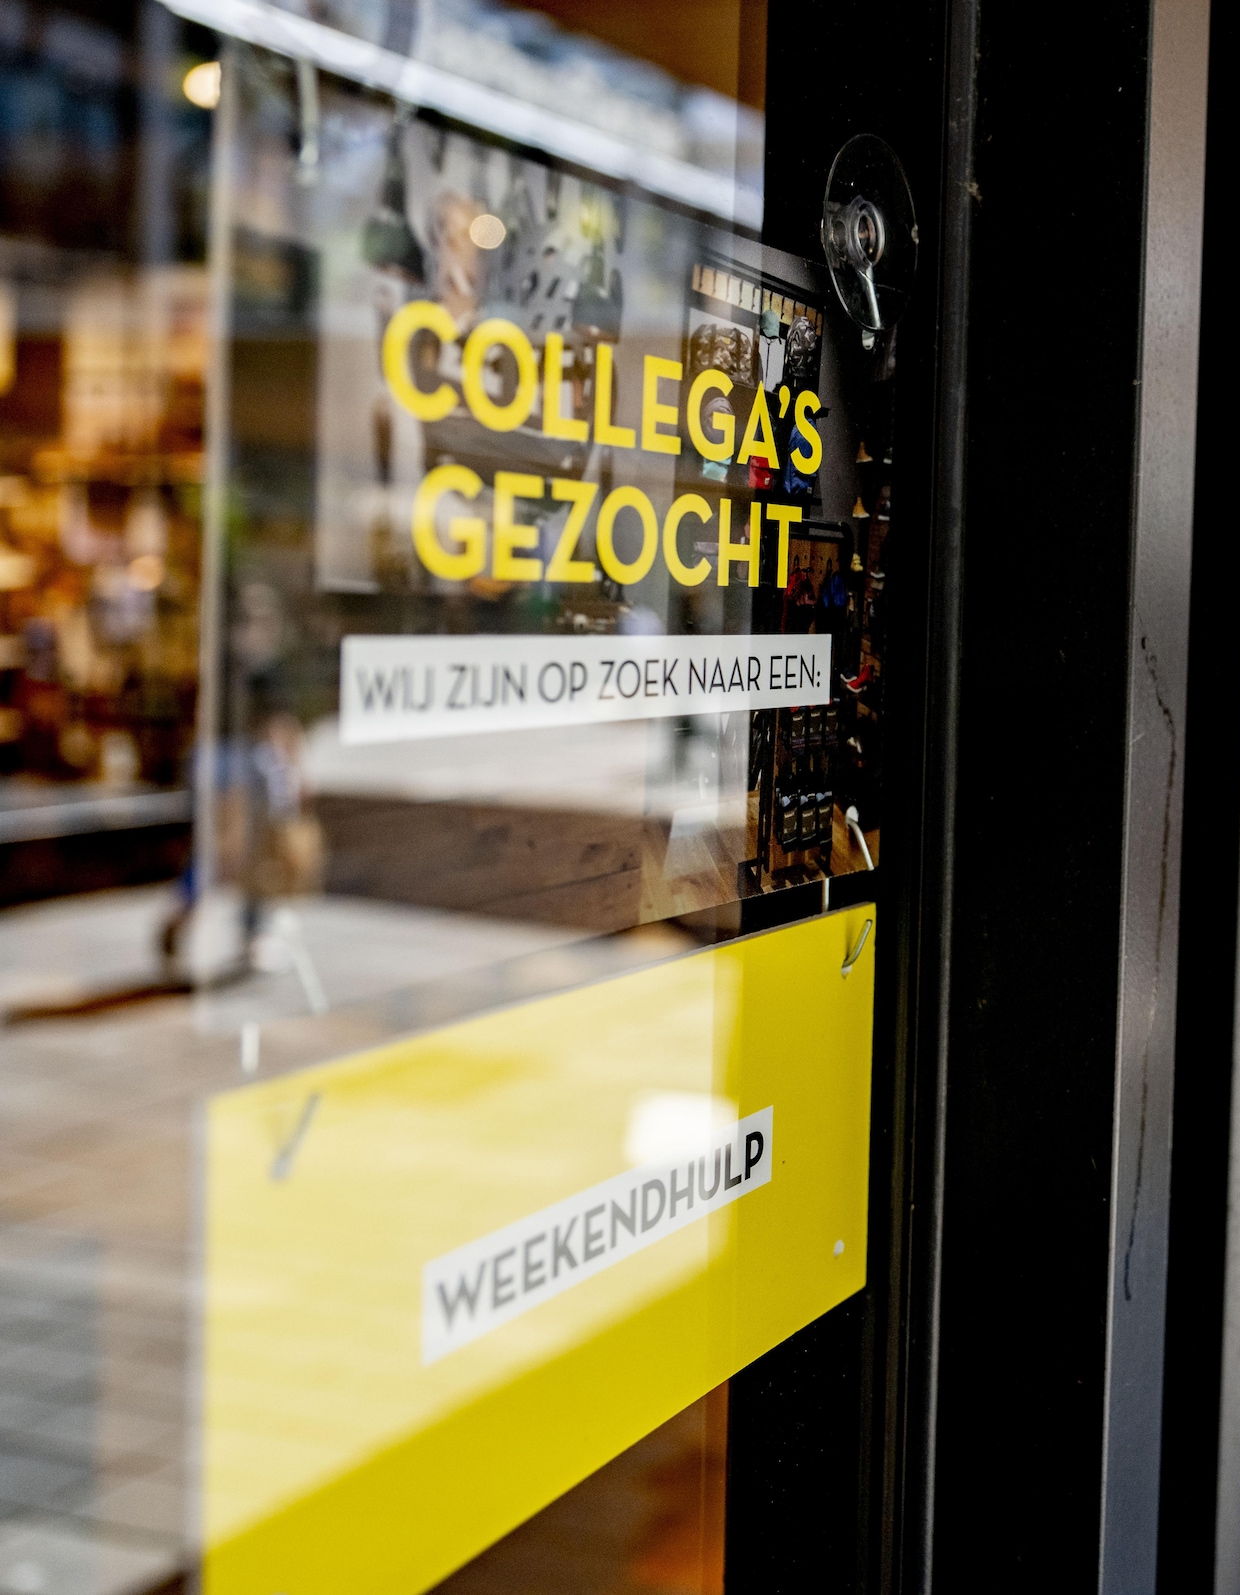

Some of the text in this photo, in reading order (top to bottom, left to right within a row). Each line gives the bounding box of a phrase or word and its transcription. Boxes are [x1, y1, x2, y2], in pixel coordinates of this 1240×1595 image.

[382, 301, 823, 475] COLLEGA'S
[413, 463, 803, 589] GEZOCHT
[356, 654, 822, 714] WIJ ZIJN OP ZOEK NAAR EEN:
[435, 1130, 765, 1334] WEEKENDHULP
